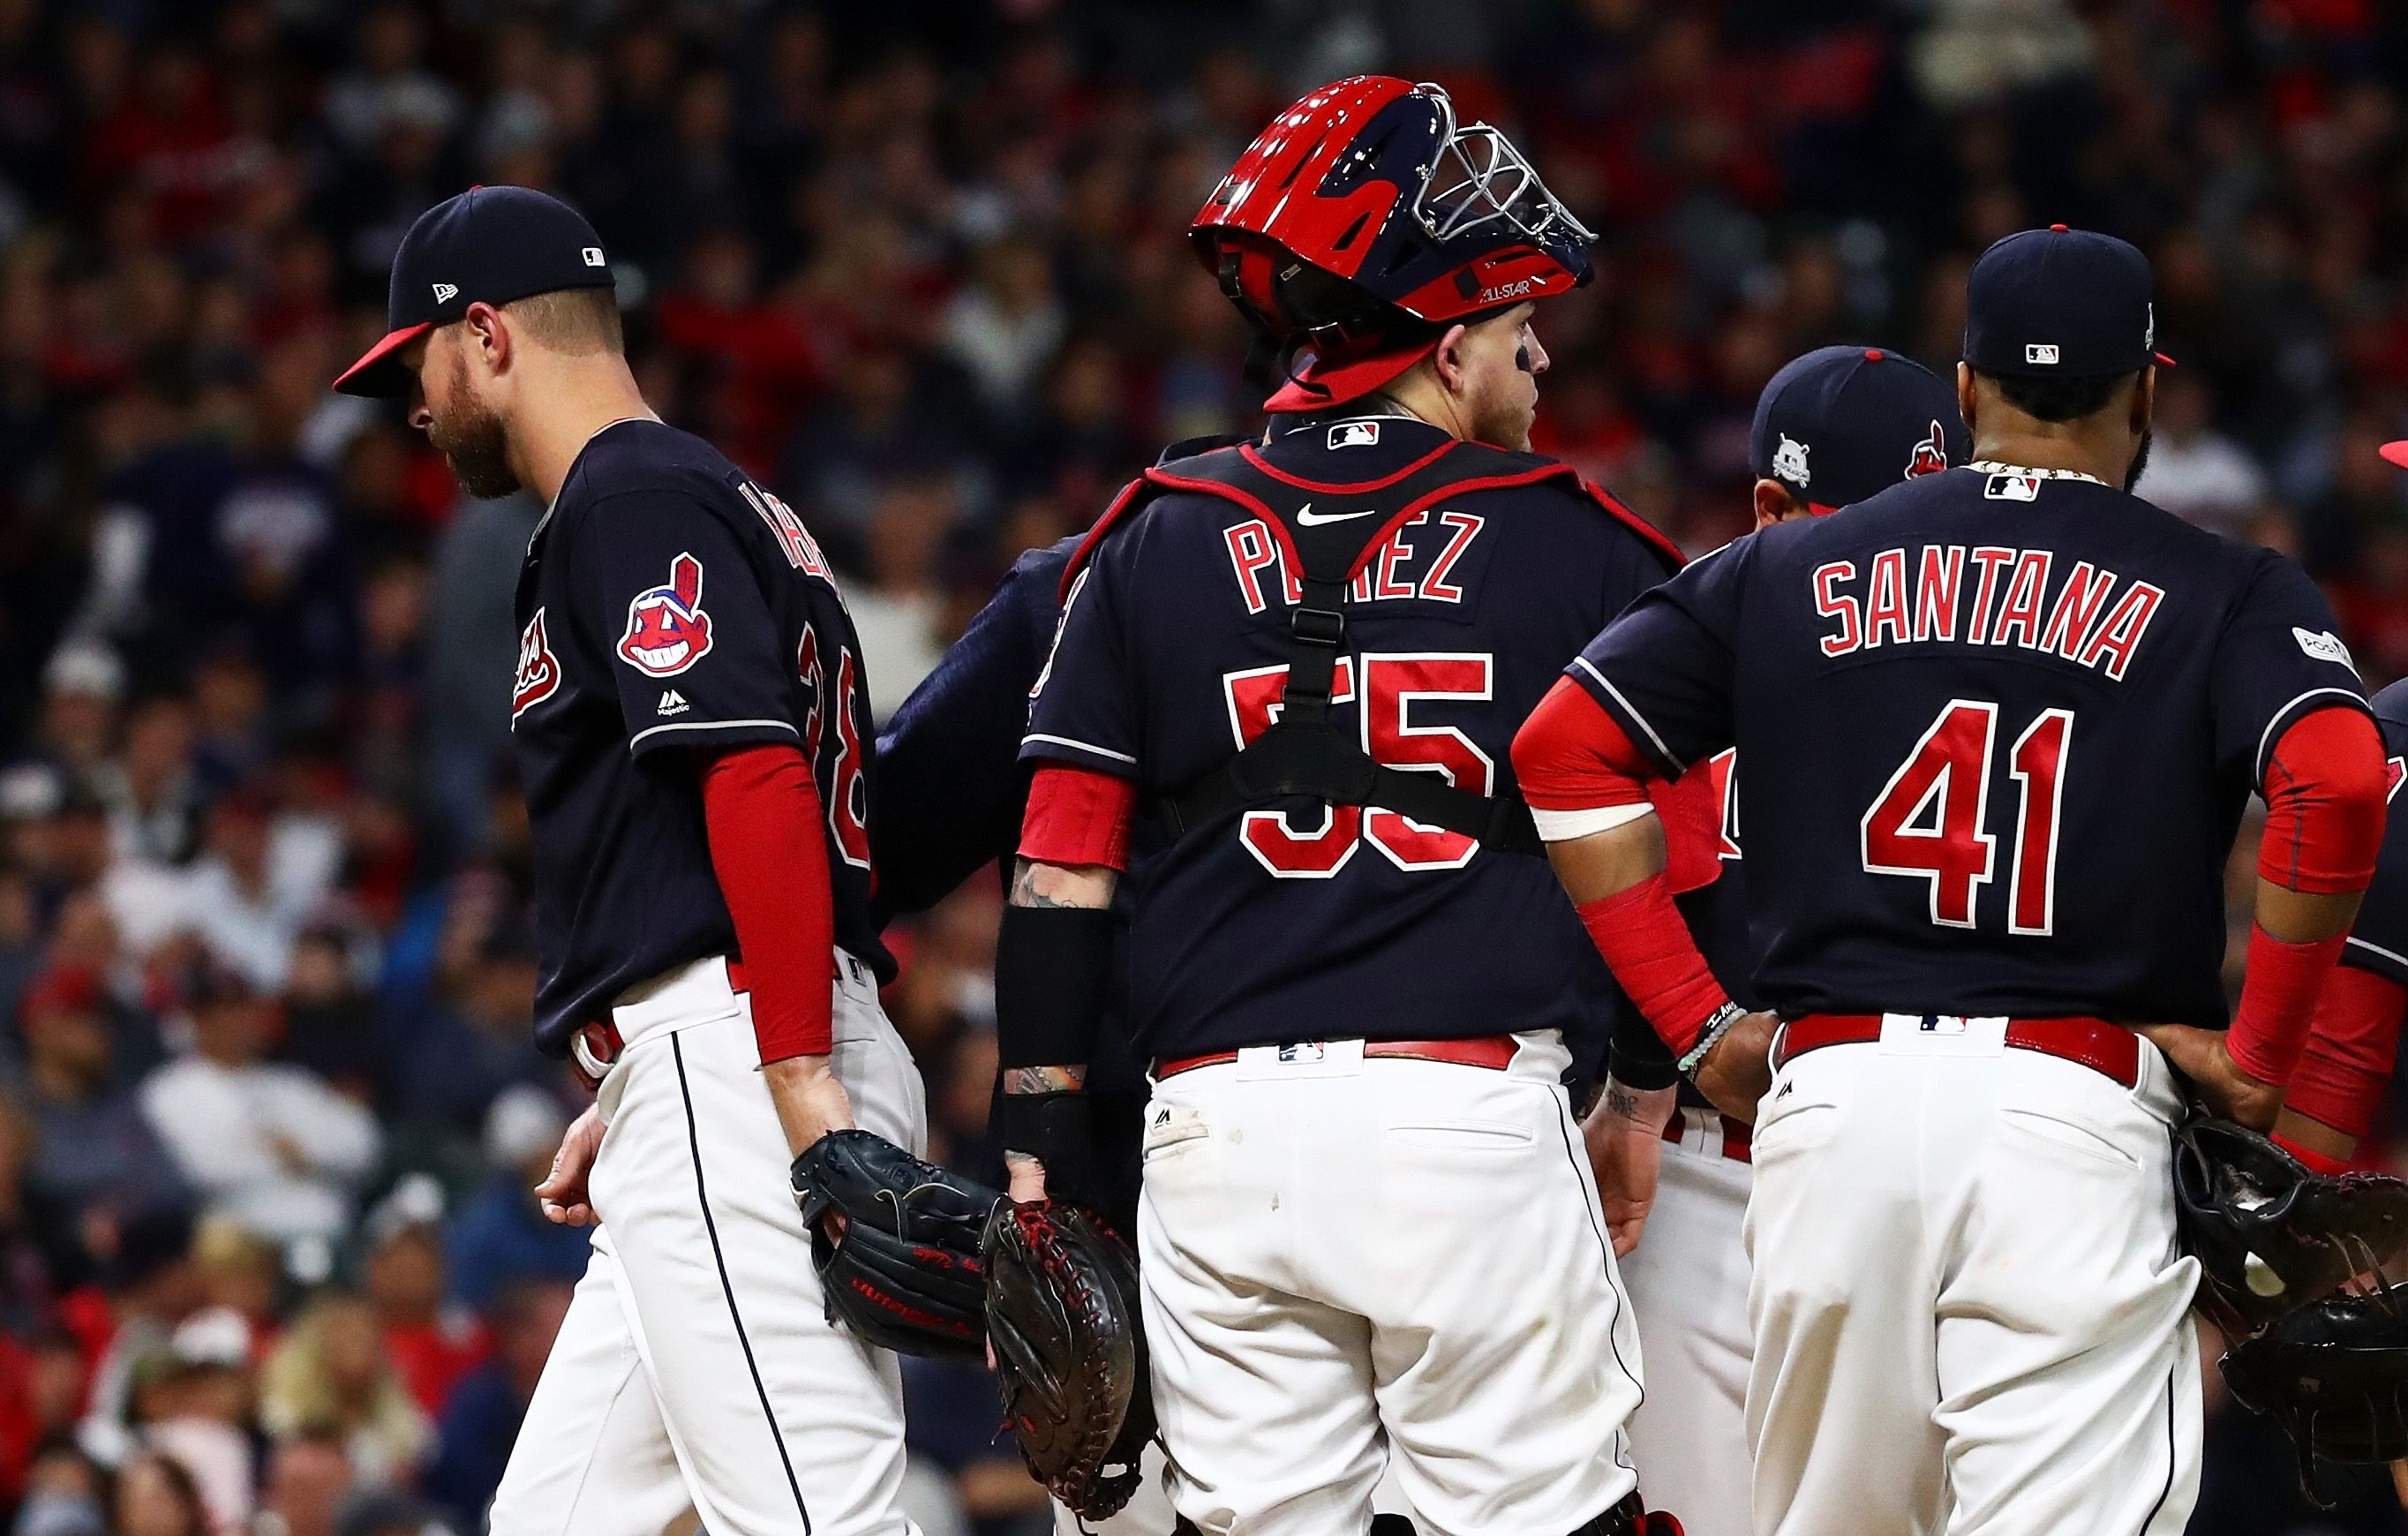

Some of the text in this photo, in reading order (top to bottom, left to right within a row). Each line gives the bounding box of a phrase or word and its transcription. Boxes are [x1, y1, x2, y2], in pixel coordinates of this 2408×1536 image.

[1479, 280, 1531, 305] ALL-STAR
[1223, 510, 1485, 614] PEZ
[1812, 545, 2165, 682] SANTANA
[1223, 652, 1494, 878] 55
[1861, 698, 2075, 937] 41
